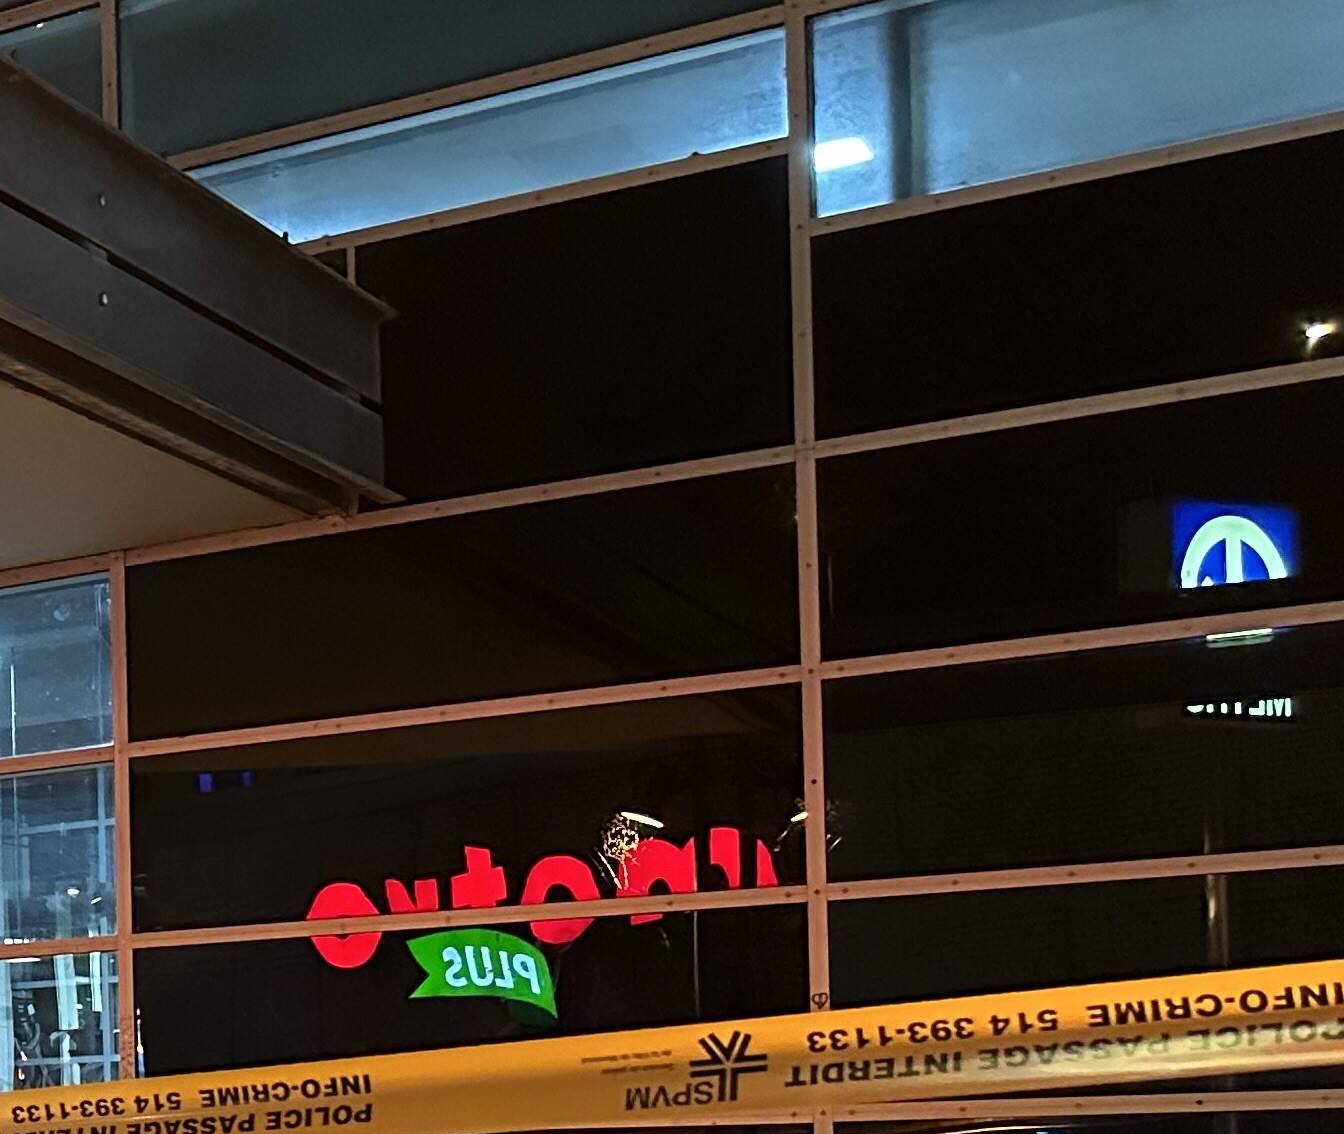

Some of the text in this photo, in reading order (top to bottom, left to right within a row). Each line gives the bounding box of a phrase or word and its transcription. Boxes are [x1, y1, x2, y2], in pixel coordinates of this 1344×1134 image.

[806, 981, 1344, 1054] INFO-CRIME 514 393-1133
[784, 1016, 1344, 1088] POLICE PASSAGE INTERDIT
[11, 1073, 372, 1124] INFO-CRIME 514 393-1133
[265, 1103, 373, 1131] POLICE
[624, 1081, 714, 1111] SPVM
